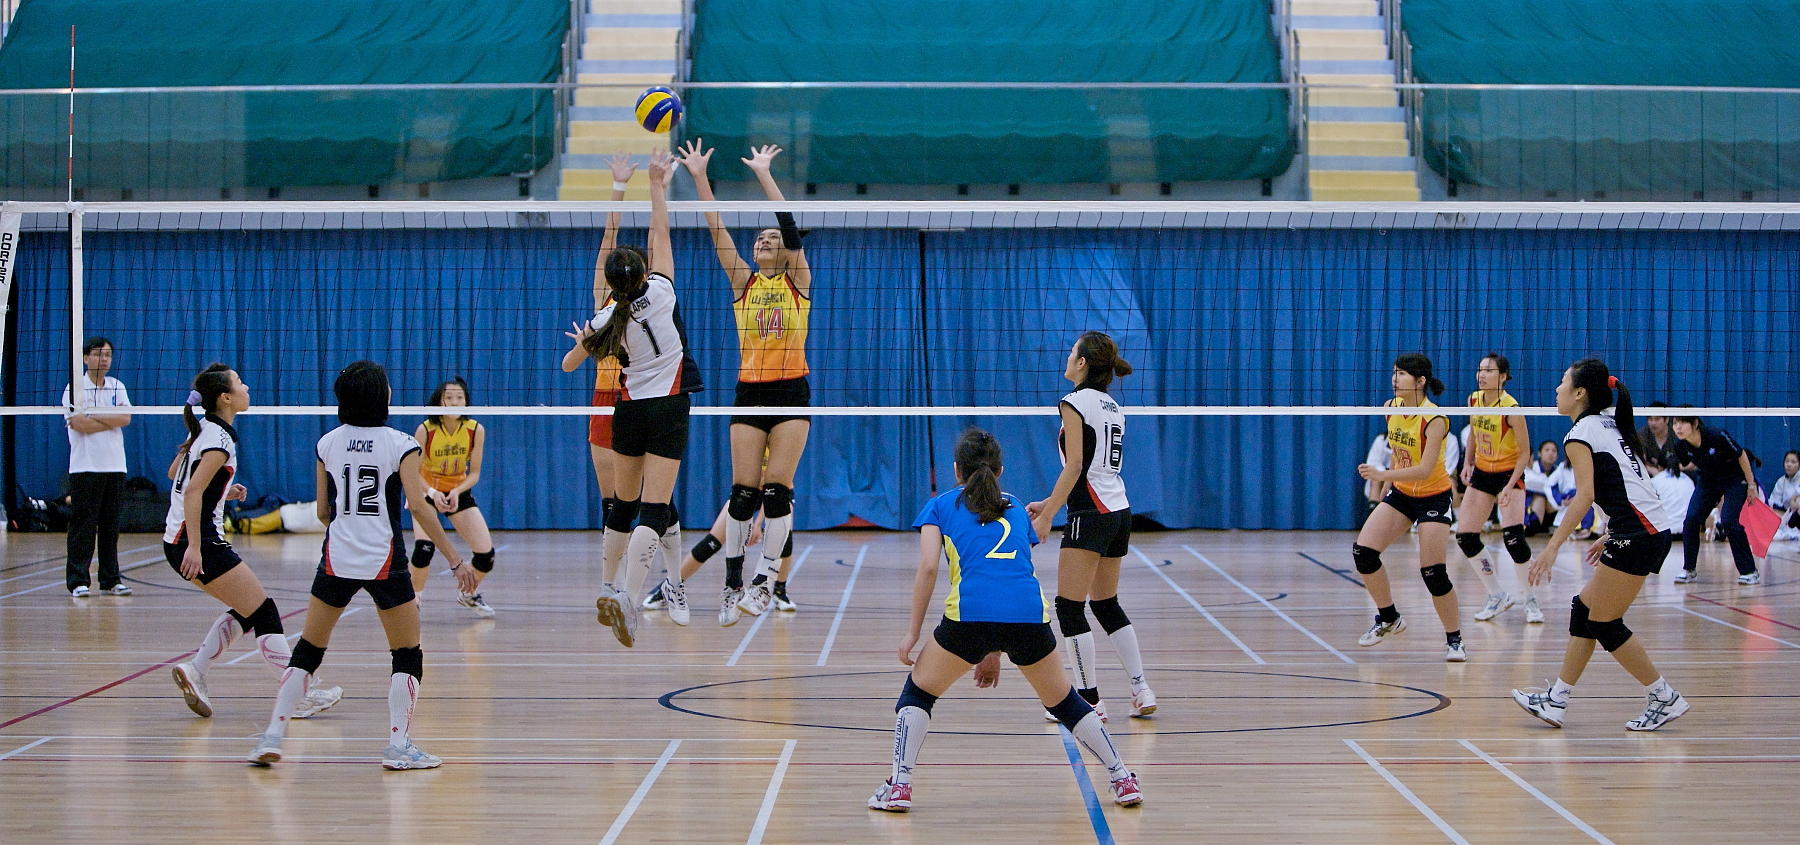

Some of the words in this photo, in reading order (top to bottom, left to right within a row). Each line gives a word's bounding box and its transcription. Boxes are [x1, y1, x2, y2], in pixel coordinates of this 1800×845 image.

[629, 296, 651, 315] AREN
[755, 307, 785, 340] 14
[640, 318, 663, 358] 1
[346, 439, 374, 453] JACKIE
[1103, 421, 1123, 471] 16
[341, 463, 381, 517] 12
[982, 516, 1018, 560] 2
